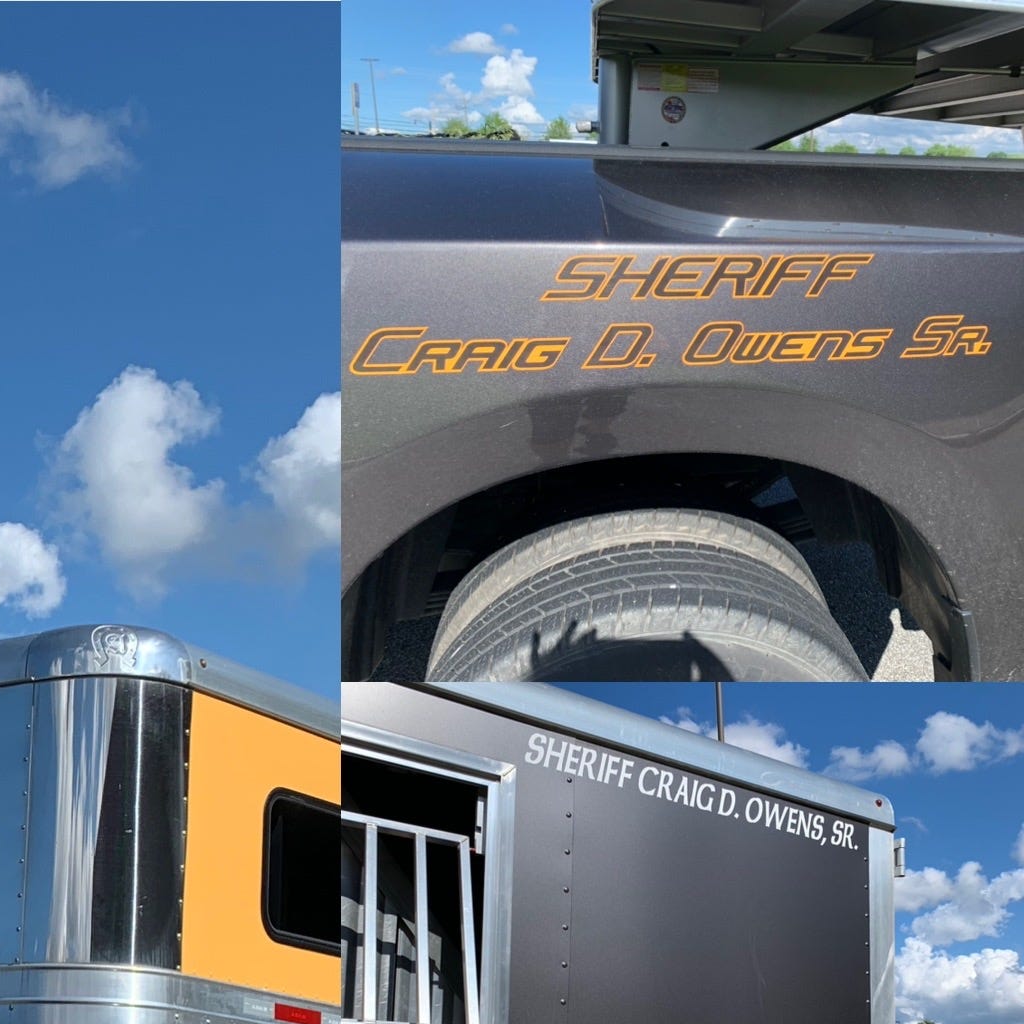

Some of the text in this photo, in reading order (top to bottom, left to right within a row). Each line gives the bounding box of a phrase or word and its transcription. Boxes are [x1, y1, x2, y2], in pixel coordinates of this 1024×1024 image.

[540, 253, 874, 301] SHERIFF
[349, 314, 992, 376] CRAIG D. OWENS SR.
[524, 733, 859, 850] SHERIFF CRAIG D. OWENS, SR.
